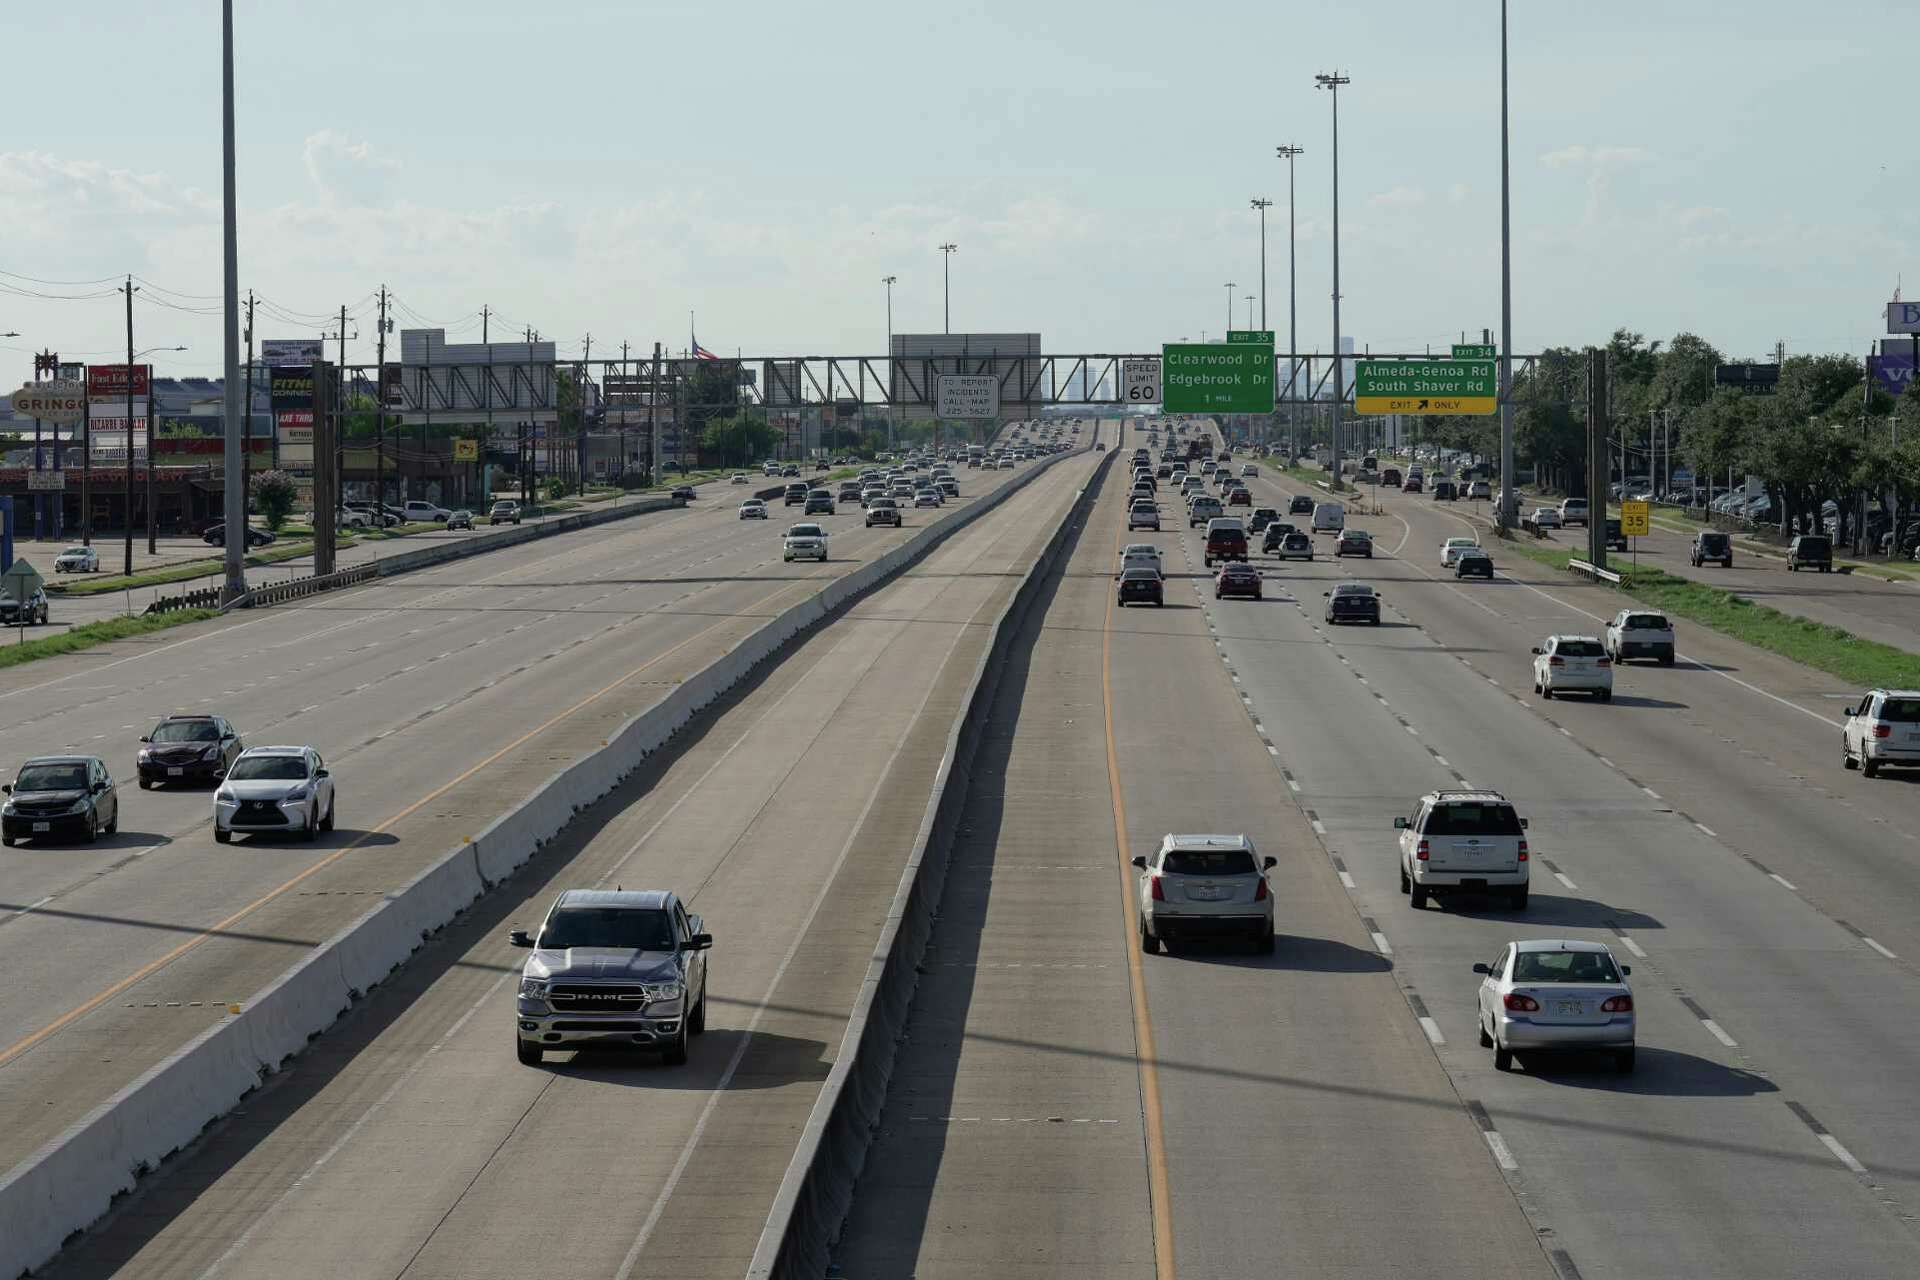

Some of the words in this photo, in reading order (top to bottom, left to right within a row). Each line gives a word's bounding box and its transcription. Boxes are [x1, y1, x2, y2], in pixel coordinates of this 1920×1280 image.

[1256, 333, 1269, 342] 35
[1478, 348, 1491, 357] 34
[1169, 354, 1242, 365] Clearwood
[1254, 354, 1268, 364] Dr
[1364, 366, 1464, 376] Almeda-Genoa
[1471, 366, 1488, 376] Rd
[1129, 375, 1154, 383] LIMIT
[1169, 374, 1241, 387] Edgebrook
[1253, 374, 1268, 384] Dr
[1368, 381, 1407, 391] South
[1414, 381, 1460, 391] Shaver
[1467, 381, 1483, 391] Rd
[1130, 386, 1154, 400] 60
[1204, 395, 1209, 403] 1
[1391, 401, 1411, 409] EXIT
[1435, 401, 1460, 409] ONLY
[120, 418, 145, 430] BAAAR
[1627, 516, 1644, 526] 35
